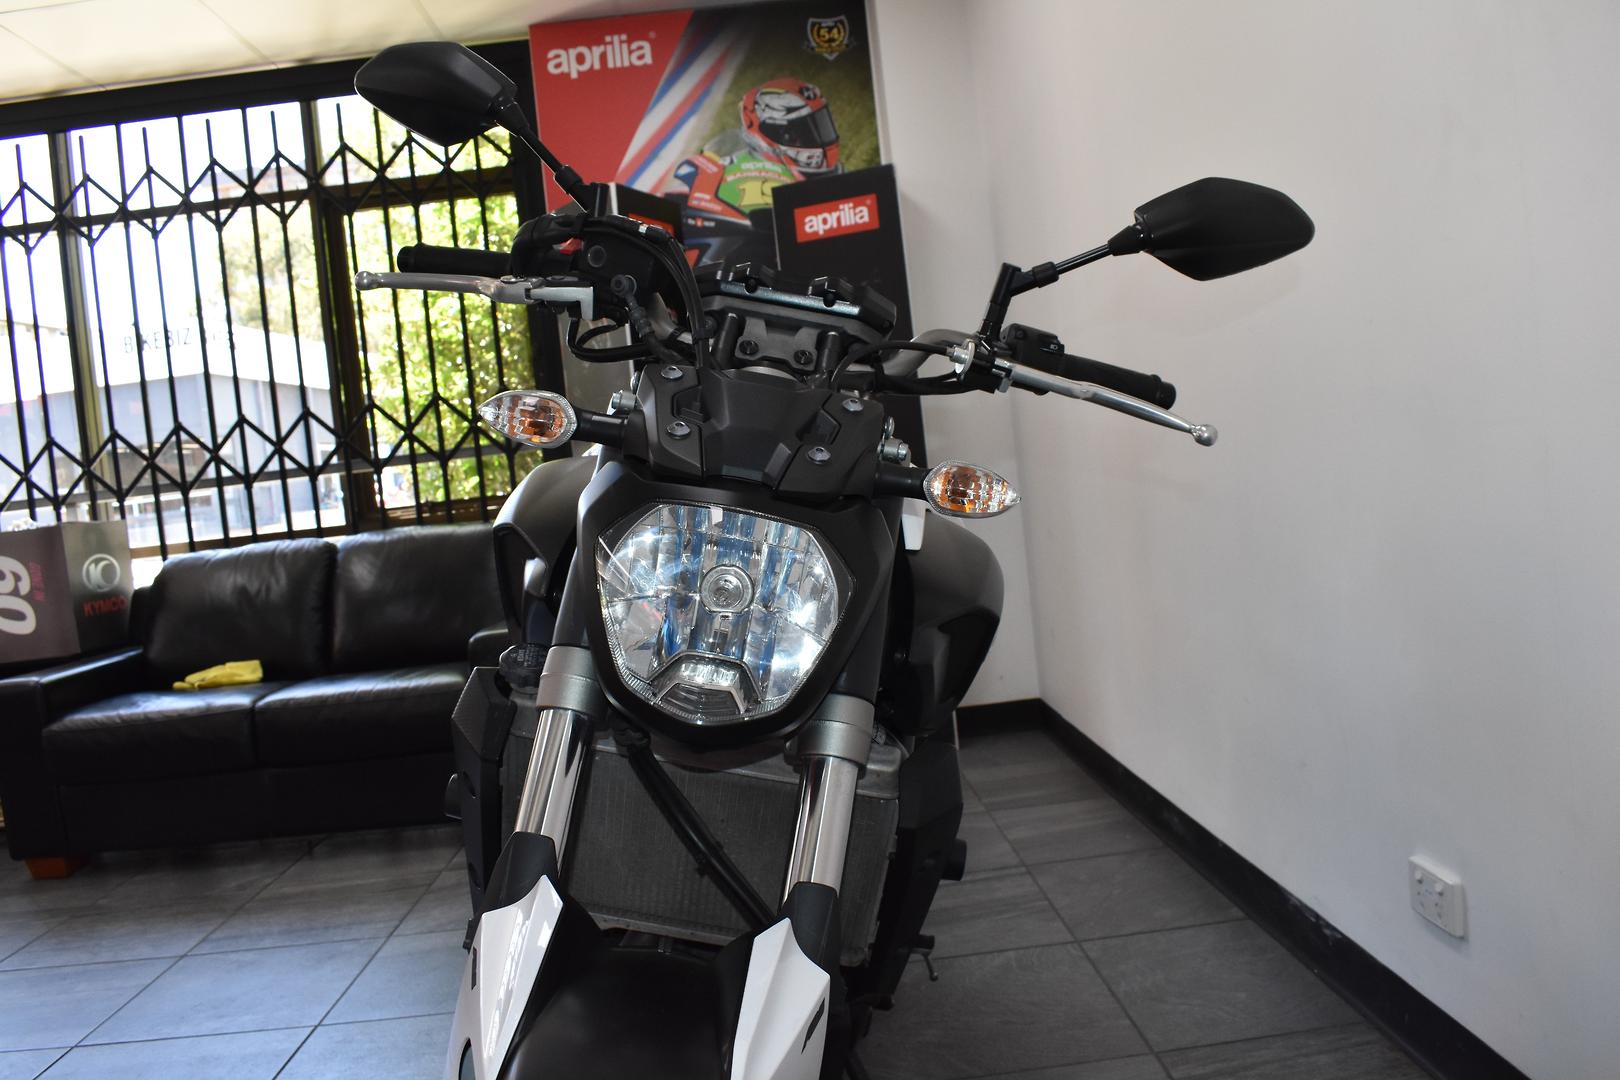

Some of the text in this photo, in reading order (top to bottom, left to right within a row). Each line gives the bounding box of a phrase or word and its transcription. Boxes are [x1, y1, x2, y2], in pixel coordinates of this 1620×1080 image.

[546, 33, 653, 80] aprilia
[803, 202, 869, 235] aprilia
[123, 327, 192, 354] BKEBIZ
